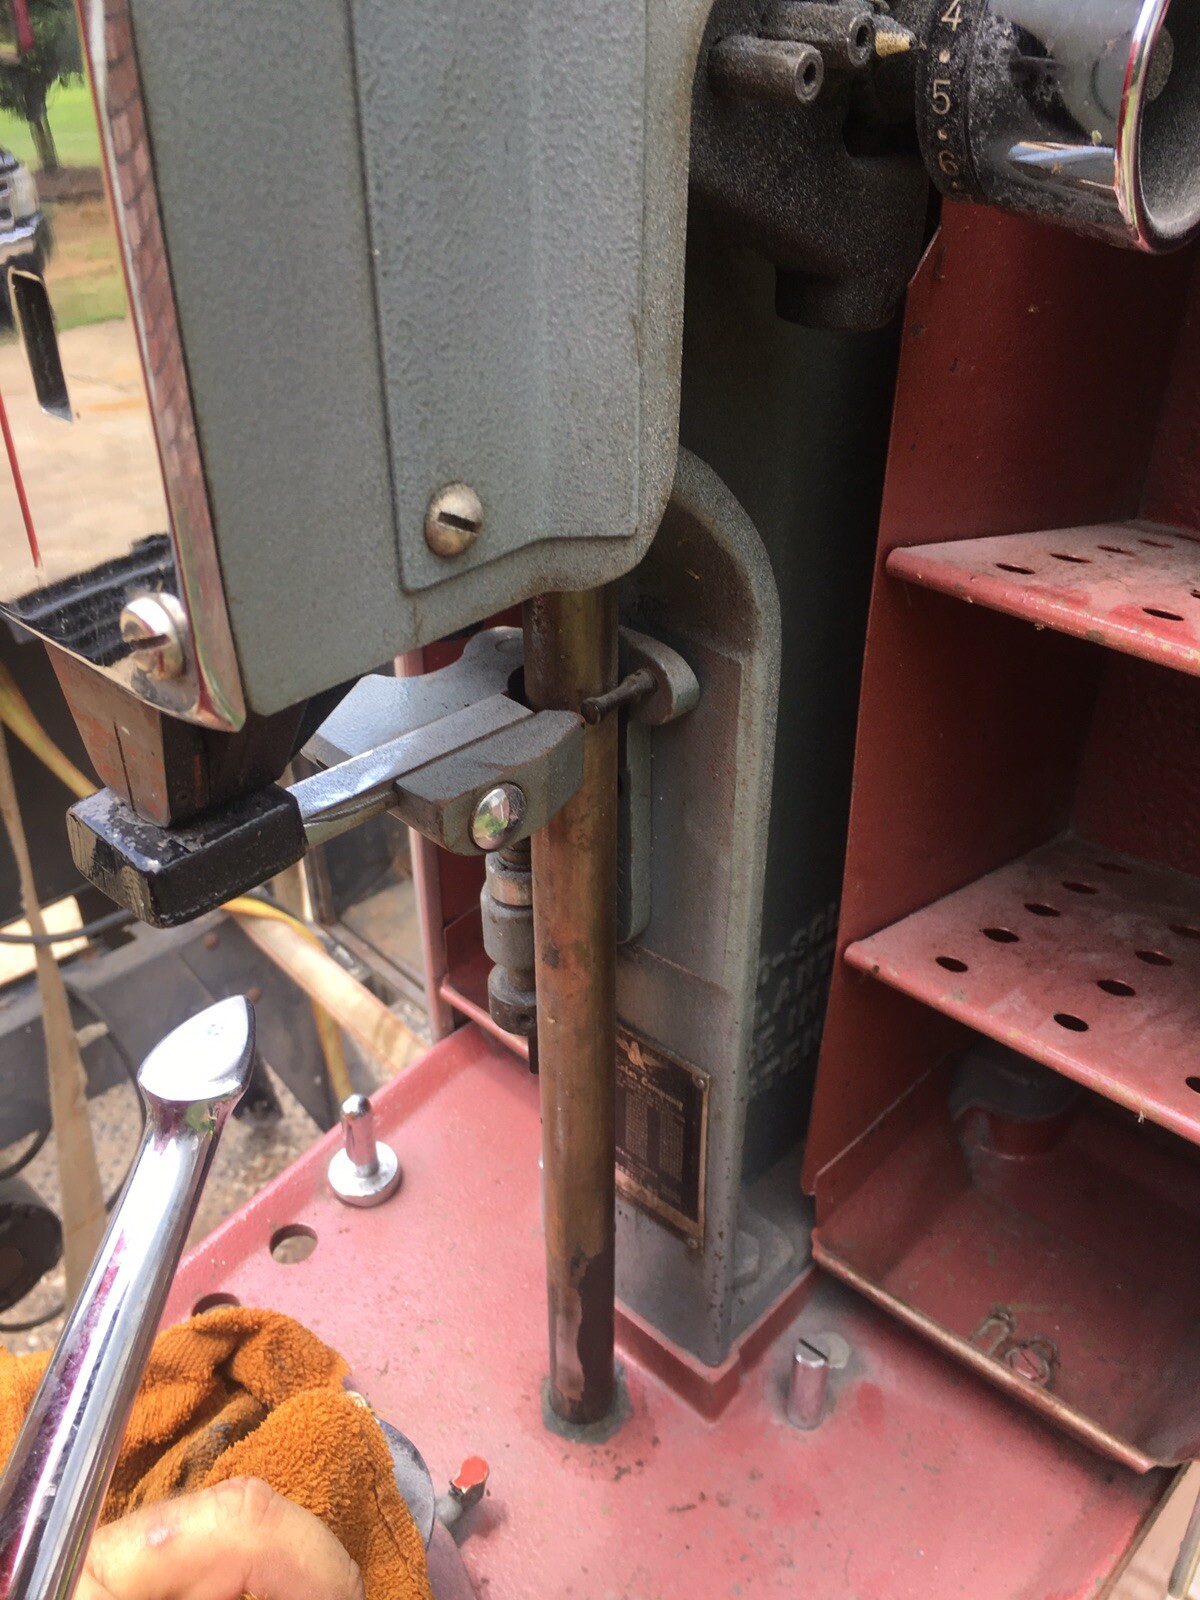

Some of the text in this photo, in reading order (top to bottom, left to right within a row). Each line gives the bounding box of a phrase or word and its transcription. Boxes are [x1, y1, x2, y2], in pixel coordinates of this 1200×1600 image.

[941, 0, 962, 31] 4
[931, 79, 951, 115] 5
[938, 150, 959, 176] 6
